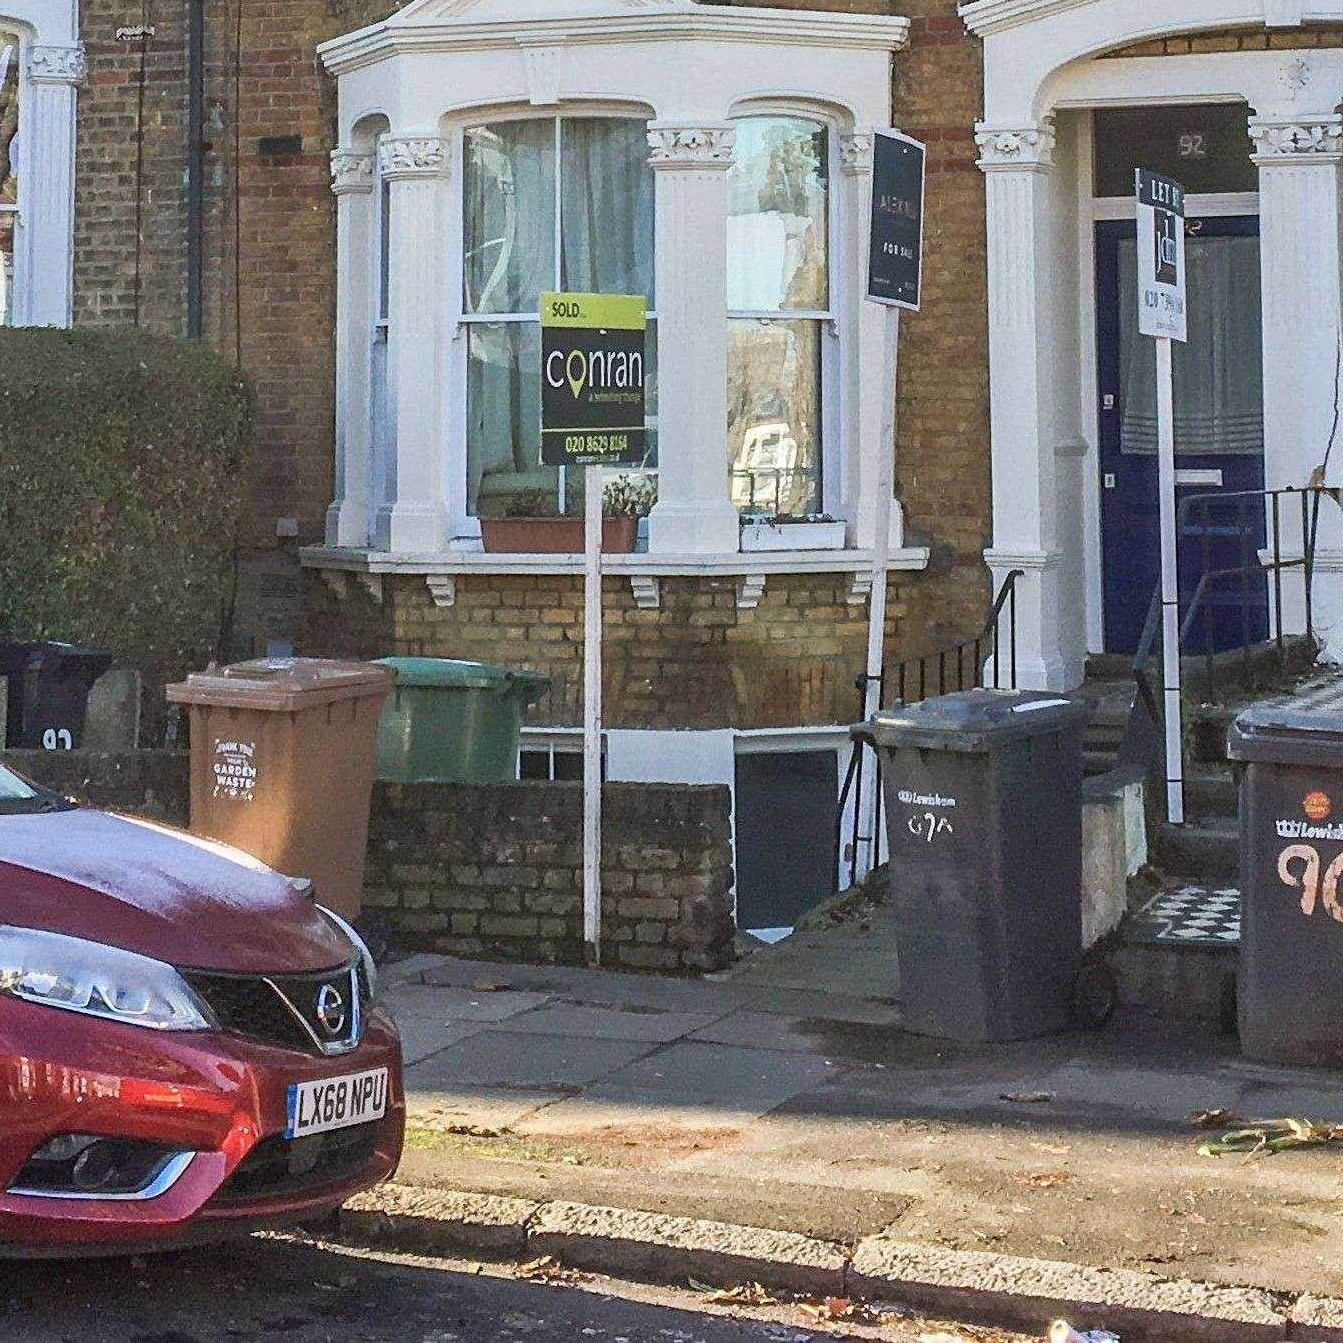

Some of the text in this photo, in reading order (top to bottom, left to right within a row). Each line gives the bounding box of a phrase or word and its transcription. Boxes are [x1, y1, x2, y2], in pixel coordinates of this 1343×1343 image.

[1180, 135, 1205, 155] 92
[1151, 179, 1169, 203] LET
[883, 242, 899, 256] FOR
[552, 301, 580, 318] SOLD
[546, 349, 643, 399] conran
[565, 435, 585, 453] 020
[213, 763, 257, 778] GARDEN
[216, 775, 252, 789] WASTE
[298, 1074, 386, 1128] LX68 NPU
